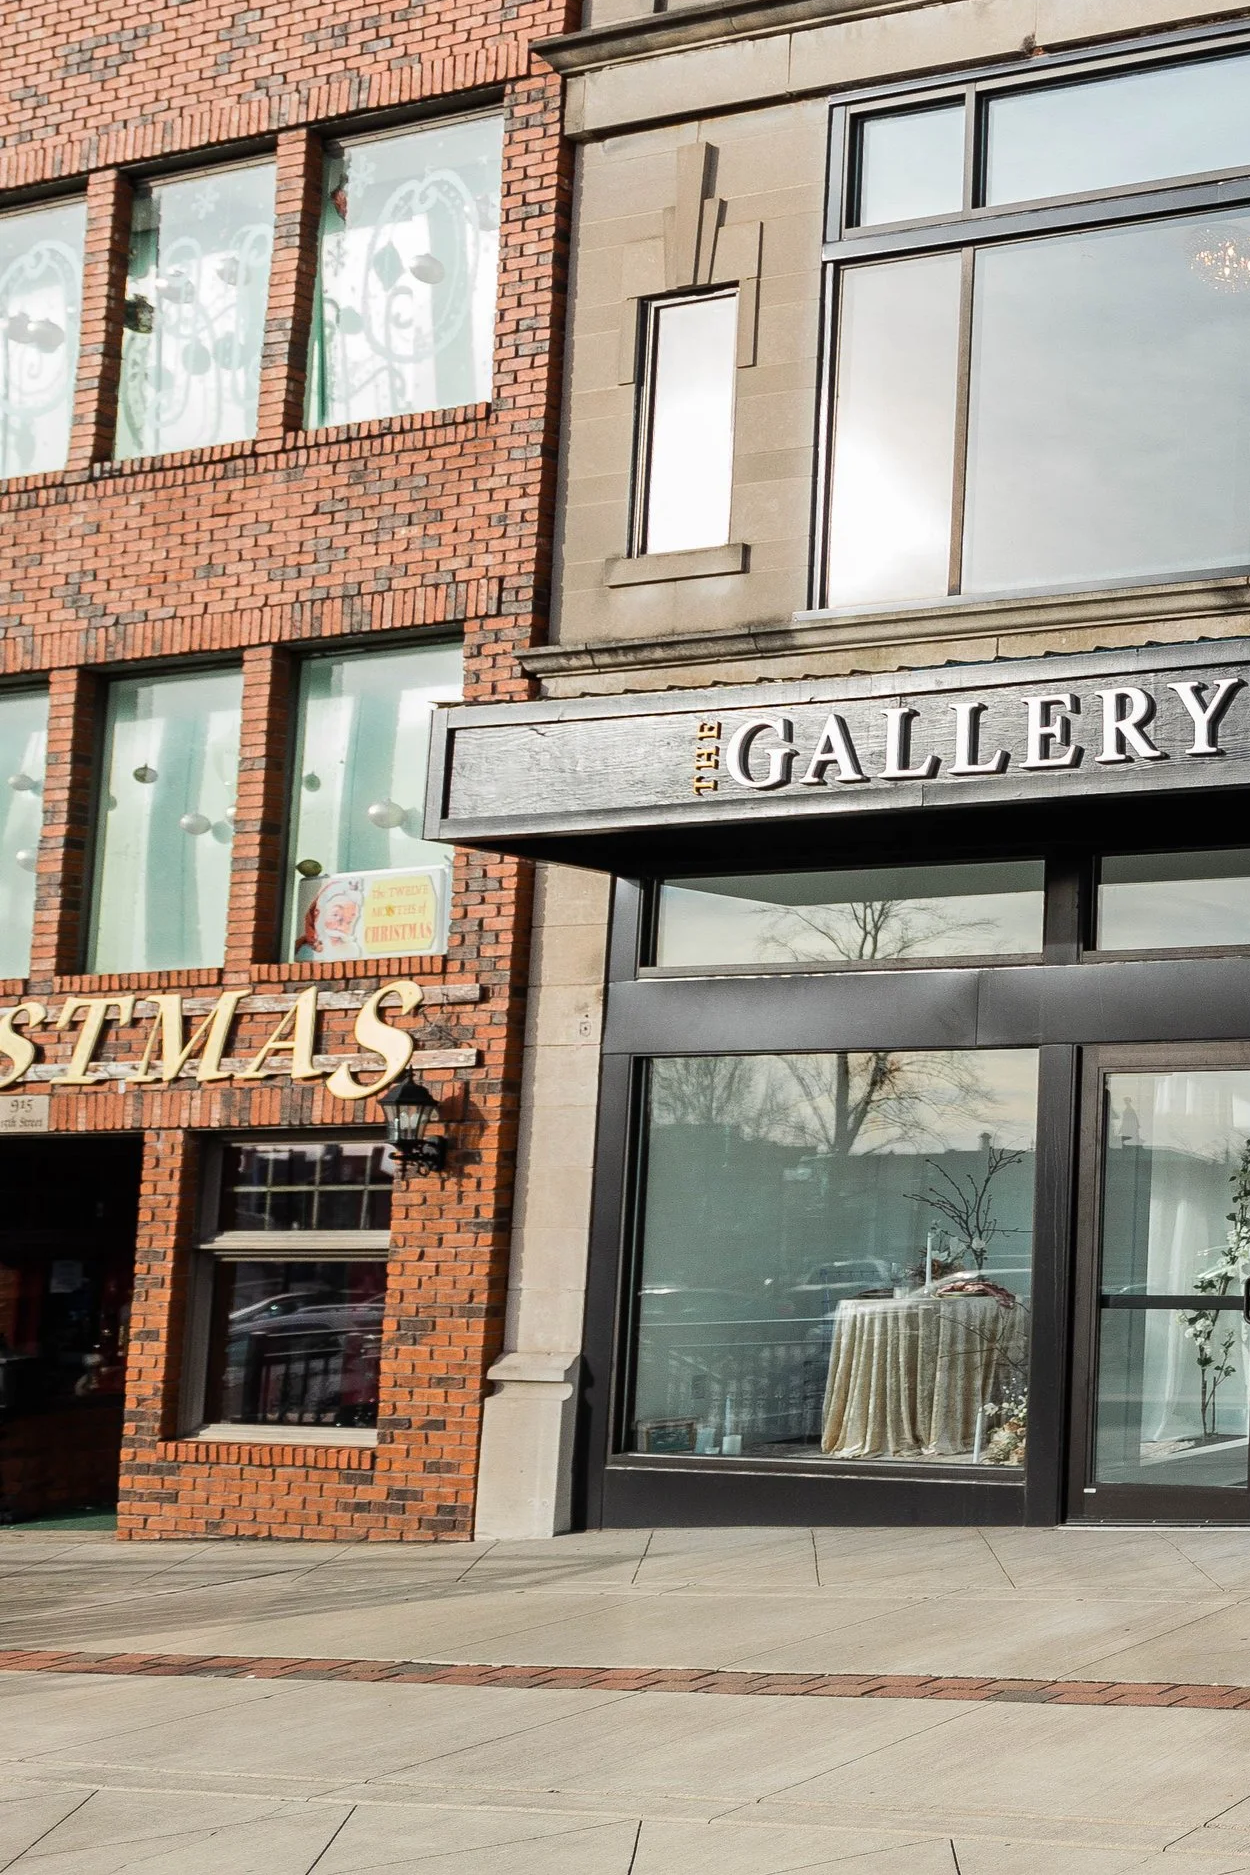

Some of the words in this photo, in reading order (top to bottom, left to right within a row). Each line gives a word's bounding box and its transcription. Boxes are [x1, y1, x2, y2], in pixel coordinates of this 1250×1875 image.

[694, 720, 722, 797] THE
[725, 677, 1245, 792] GALLERY
[388, 884, 429, 898] TWELVE
[364, 922, 433, 944] CHRISTMAS
[0, 980, 423, 1100] STMAS
[10, 1099, 33, 1113] 915
